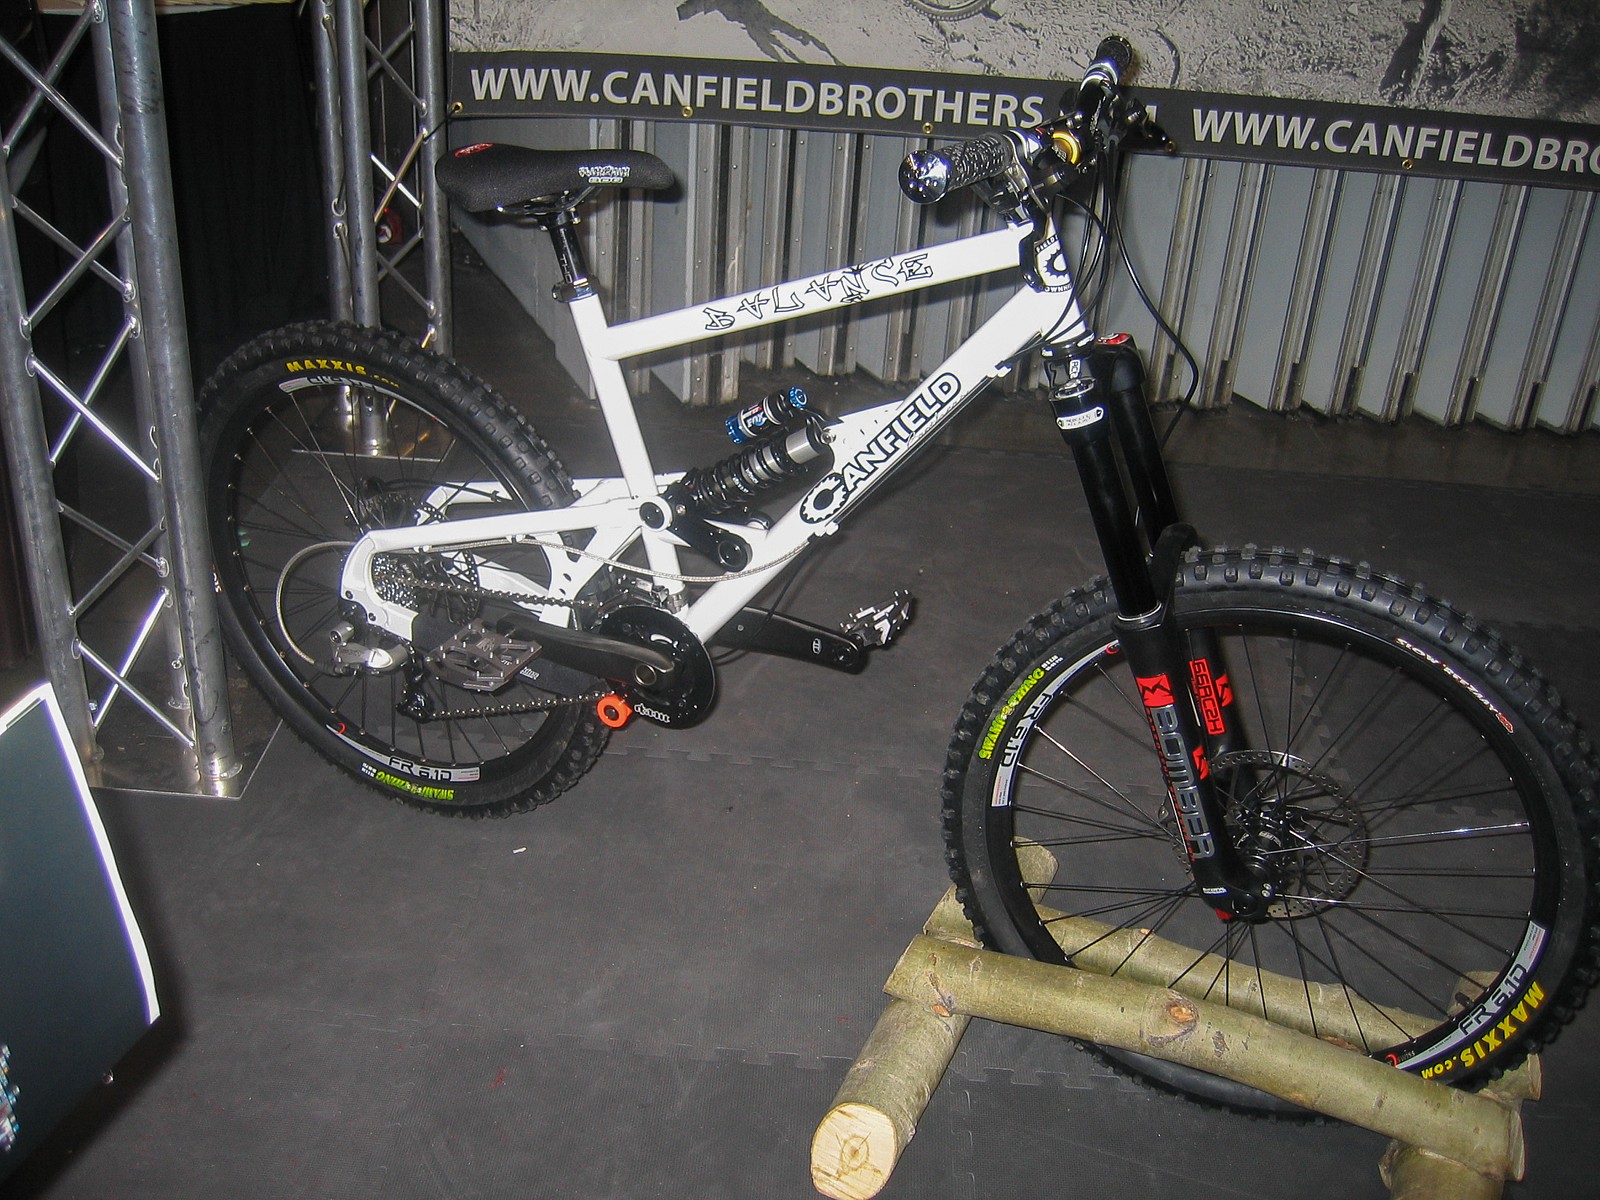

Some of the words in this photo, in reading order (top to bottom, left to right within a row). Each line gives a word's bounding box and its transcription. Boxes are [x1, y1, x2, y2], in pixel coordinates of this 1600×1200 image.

[470, 67, 1157, 128] WWW.CANFIELDBROTHERS
[745, 411, 765, 429] FOX
[799, 371, 961, 525] CANFIELD
[1149, 703, 1216, 860] BOMBER
[1457, 1002, 1497, 1037] FR
